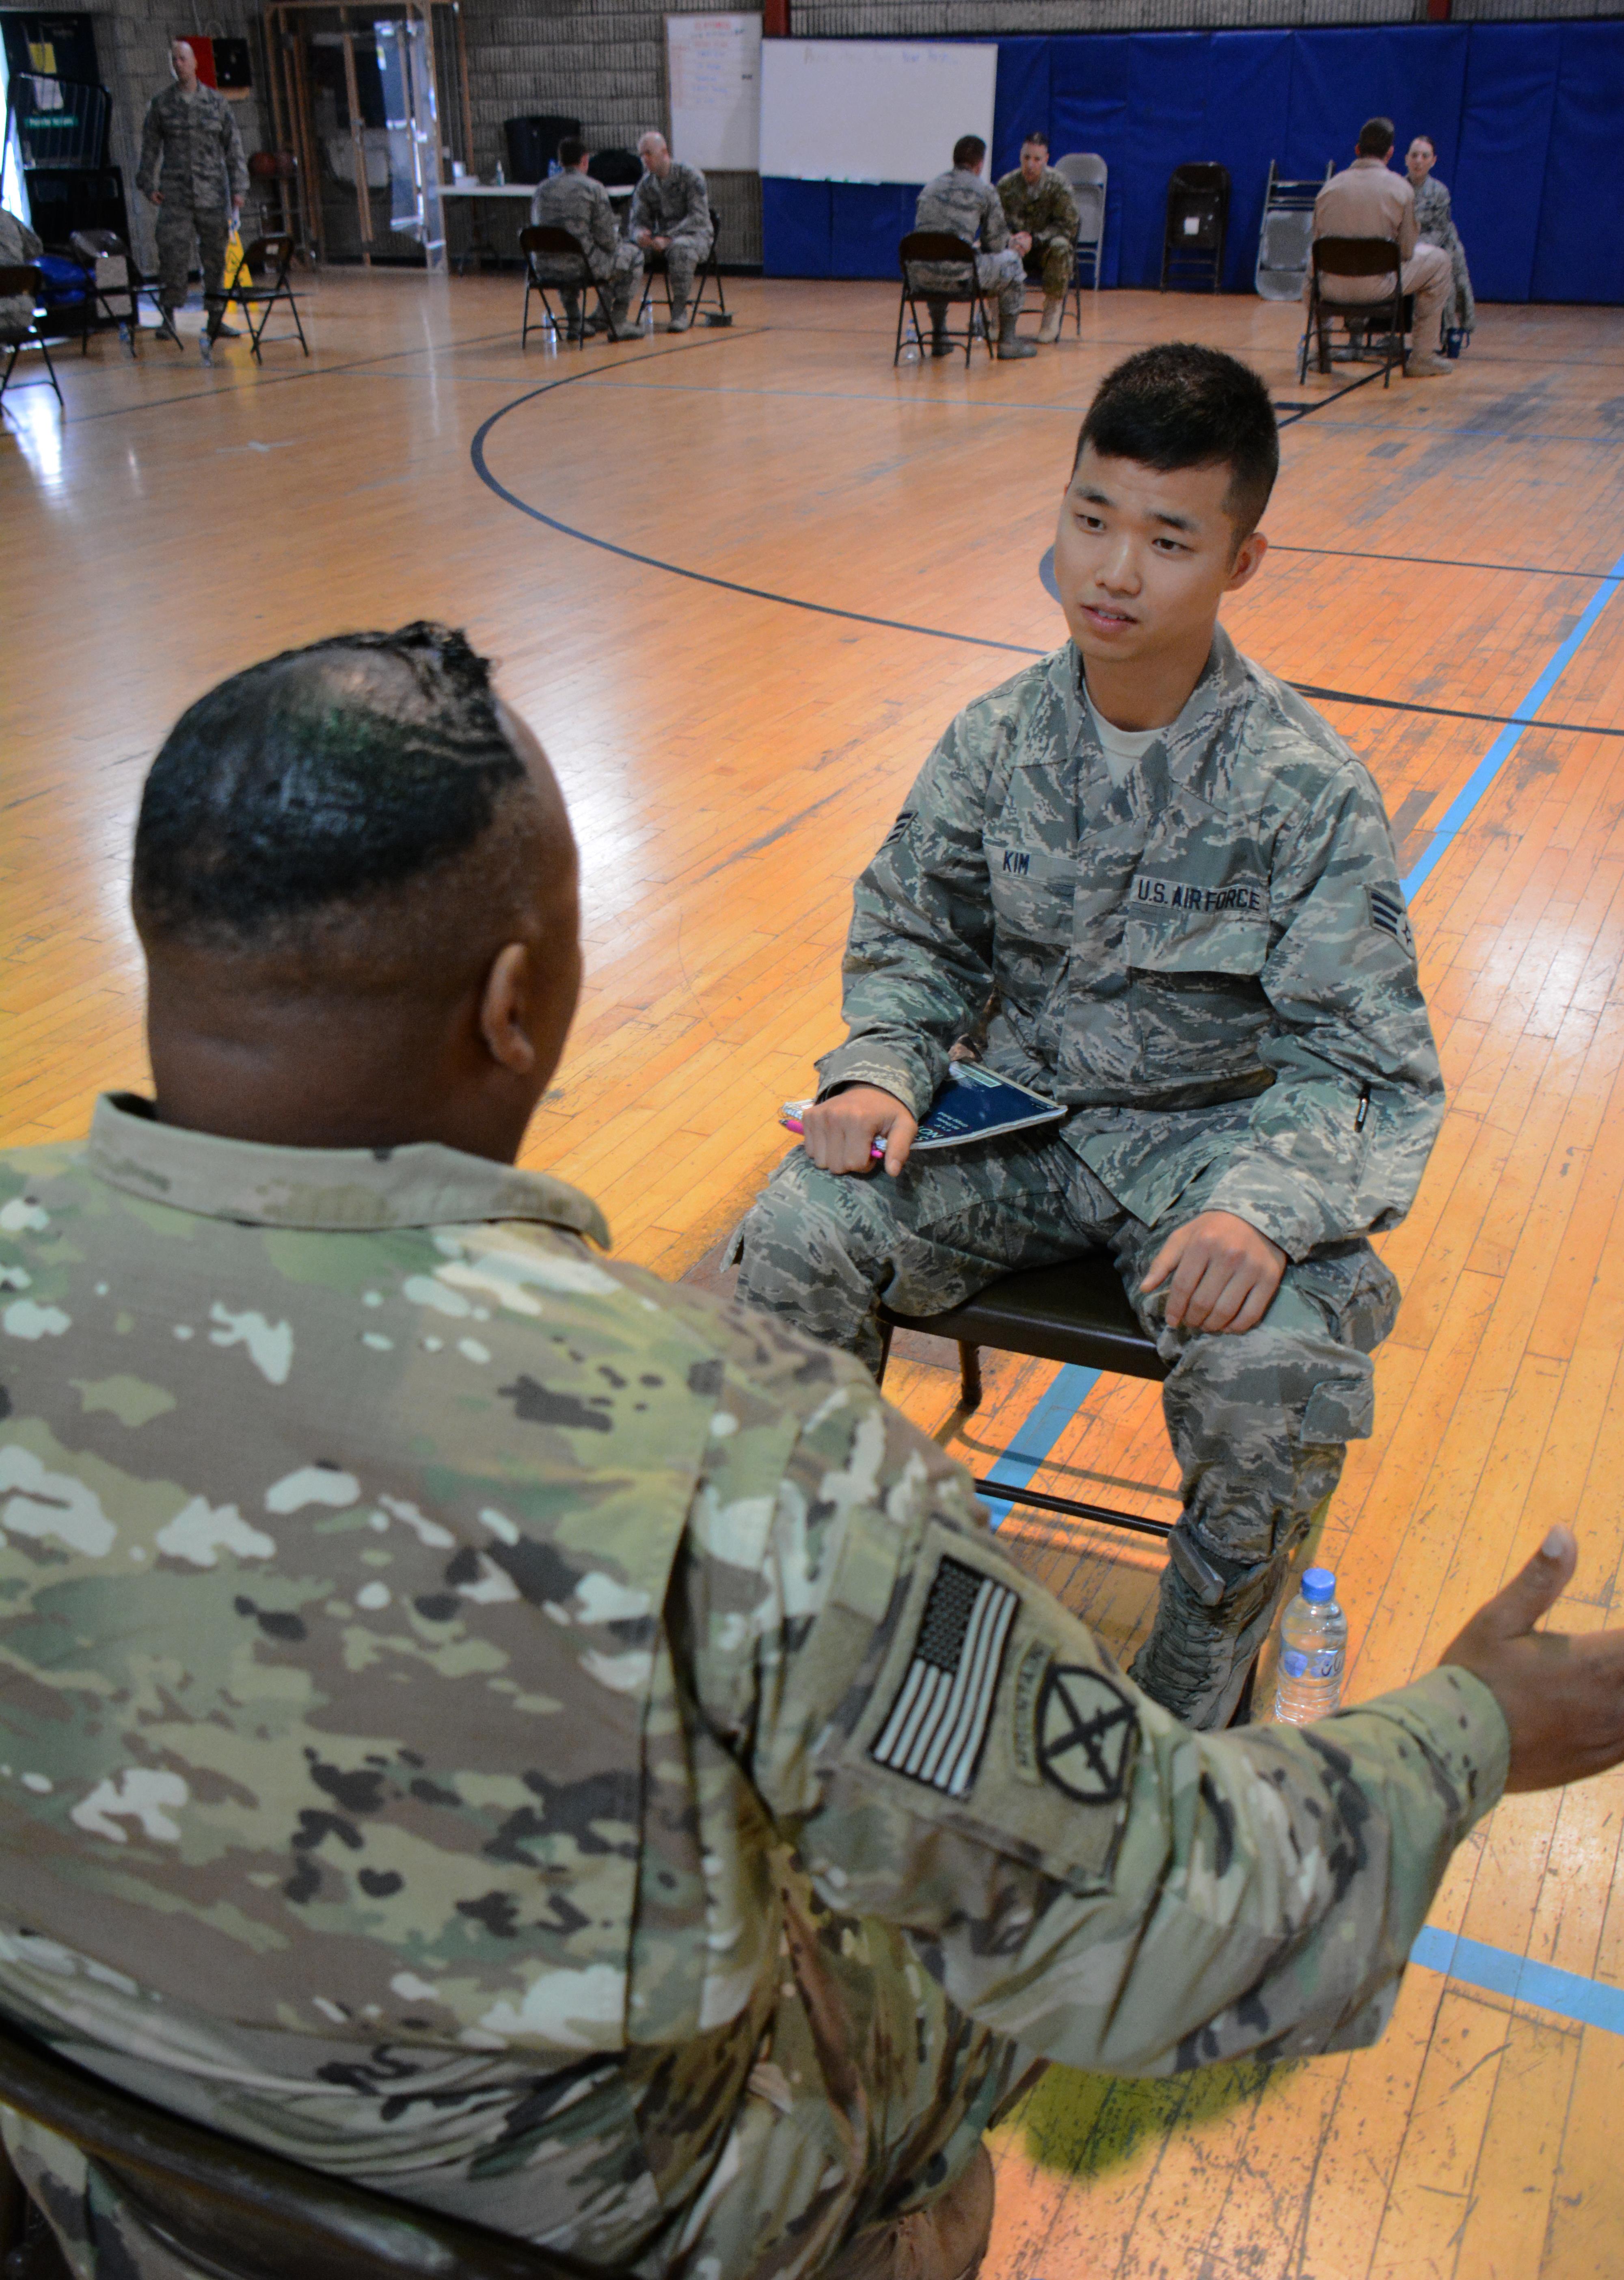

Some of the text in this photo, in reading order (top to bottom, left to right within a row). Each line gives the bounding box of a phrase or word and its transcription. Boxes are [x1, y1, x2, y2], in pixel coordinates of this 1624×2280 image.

[1003, 851, 1030, 875] KIM
[1138, 879, 1260, 911] U.S. AIR FORCE
